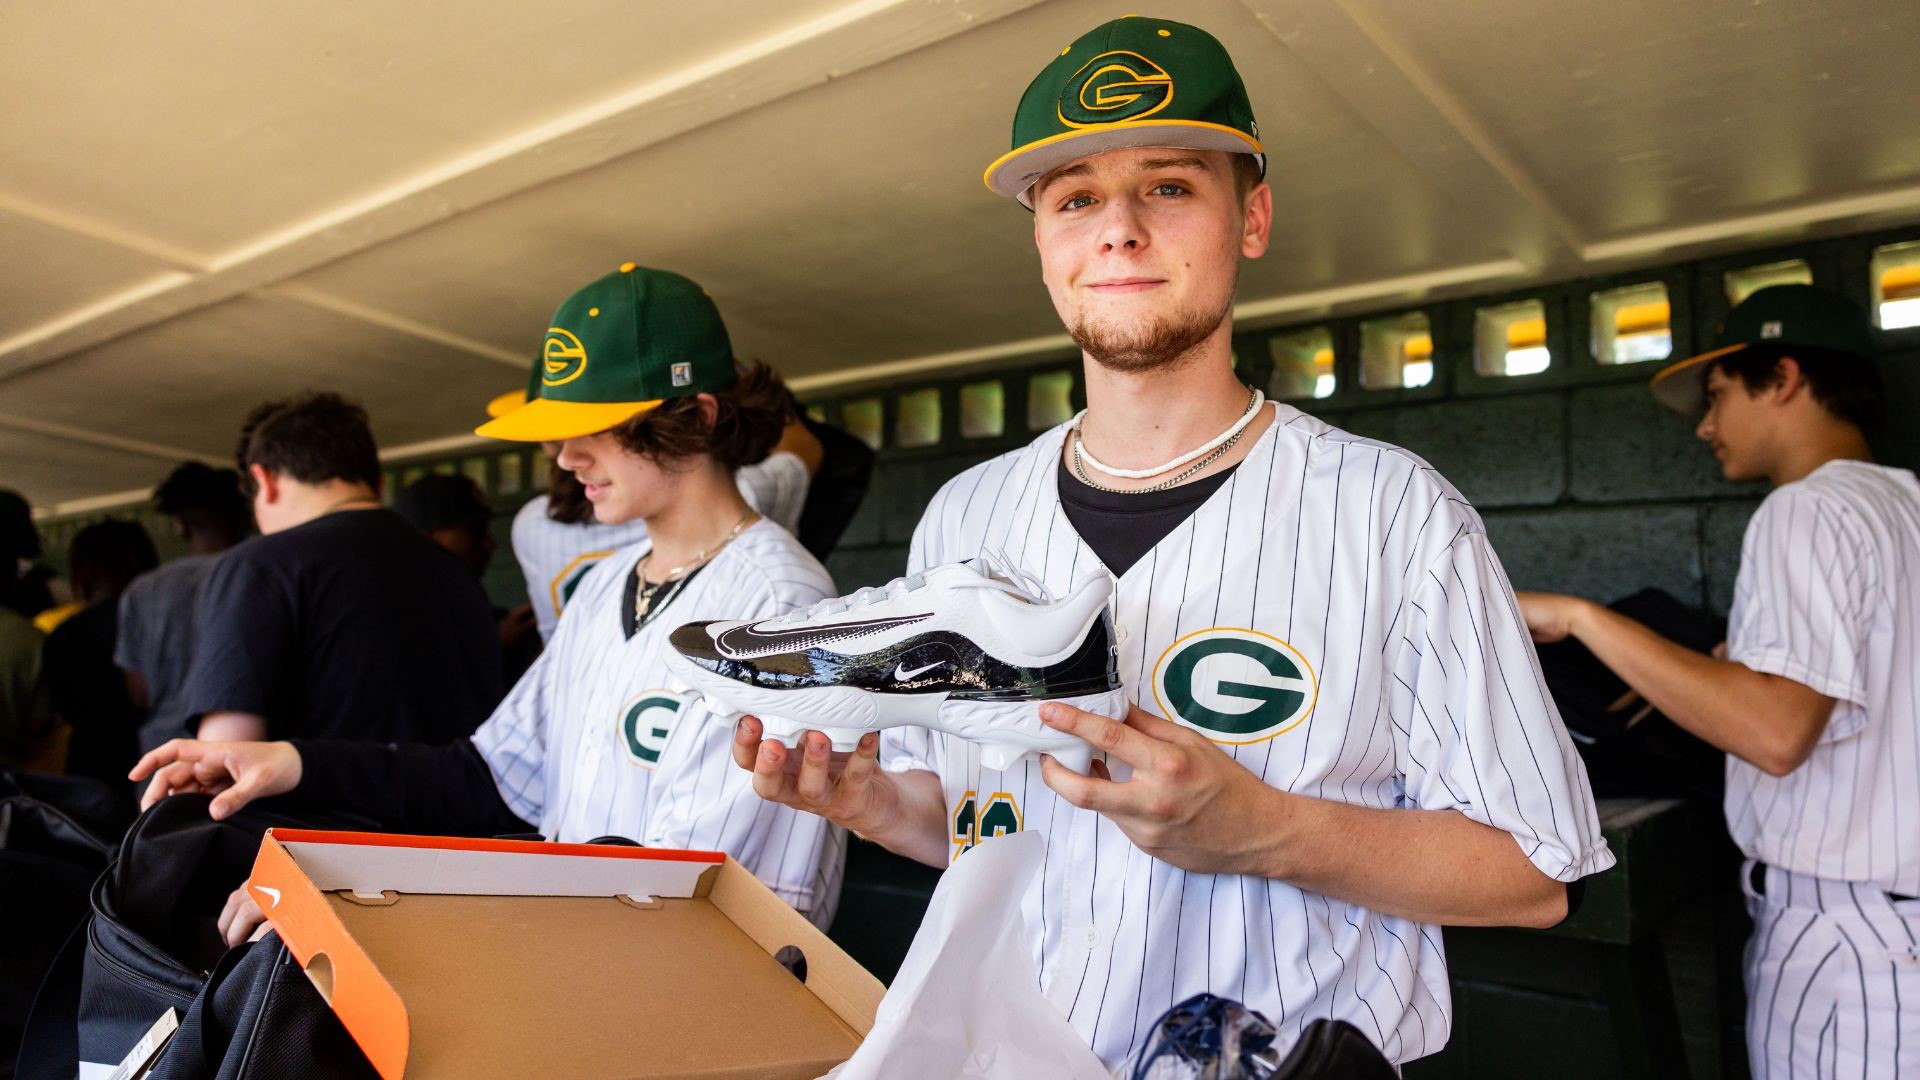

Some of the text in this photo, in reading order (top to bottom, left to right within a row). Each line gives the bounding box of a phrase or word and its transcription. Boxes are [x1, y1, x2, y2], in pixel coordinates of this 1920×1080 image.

[1058, 50, 1174, 129] G
[543, 327, 588, 387] G
[1163, 637, 1305, 734] G
[624, 696, 681, 763] G
